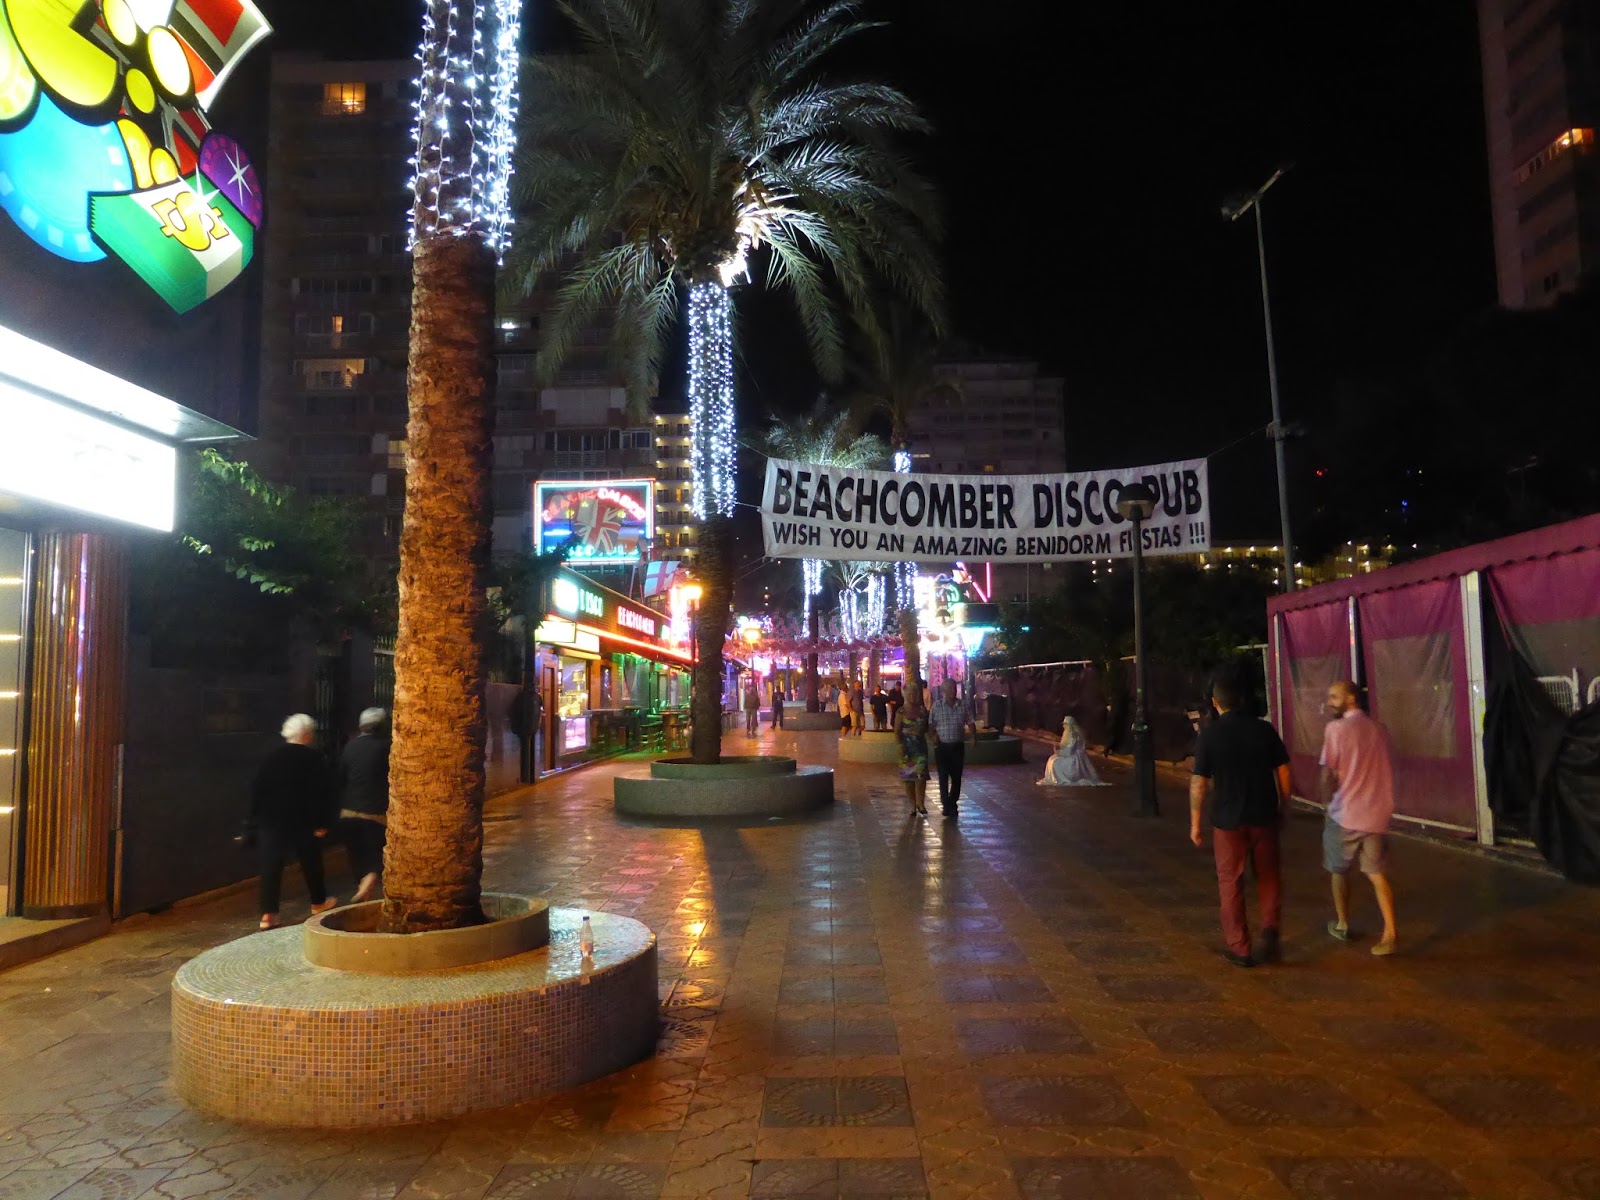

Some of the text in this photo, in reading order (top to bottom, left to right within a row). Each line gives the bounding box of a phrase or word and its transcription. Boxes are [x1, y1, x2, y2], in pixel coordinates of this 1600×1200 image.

[772, 468, 1018, 530] BEACHCOMBER
[1033, 478, 1126, 529] DISCO
[773, 522, 821, 547] WISH
[830, 527, 868, 549] YOU
[876, 532, 904, 553] AN
[913, 535, 1008, 556] AMAZING
[1016, 532, 1112, 556] BENIDORM
[1119, 524, 1181, 551] FISTAS
